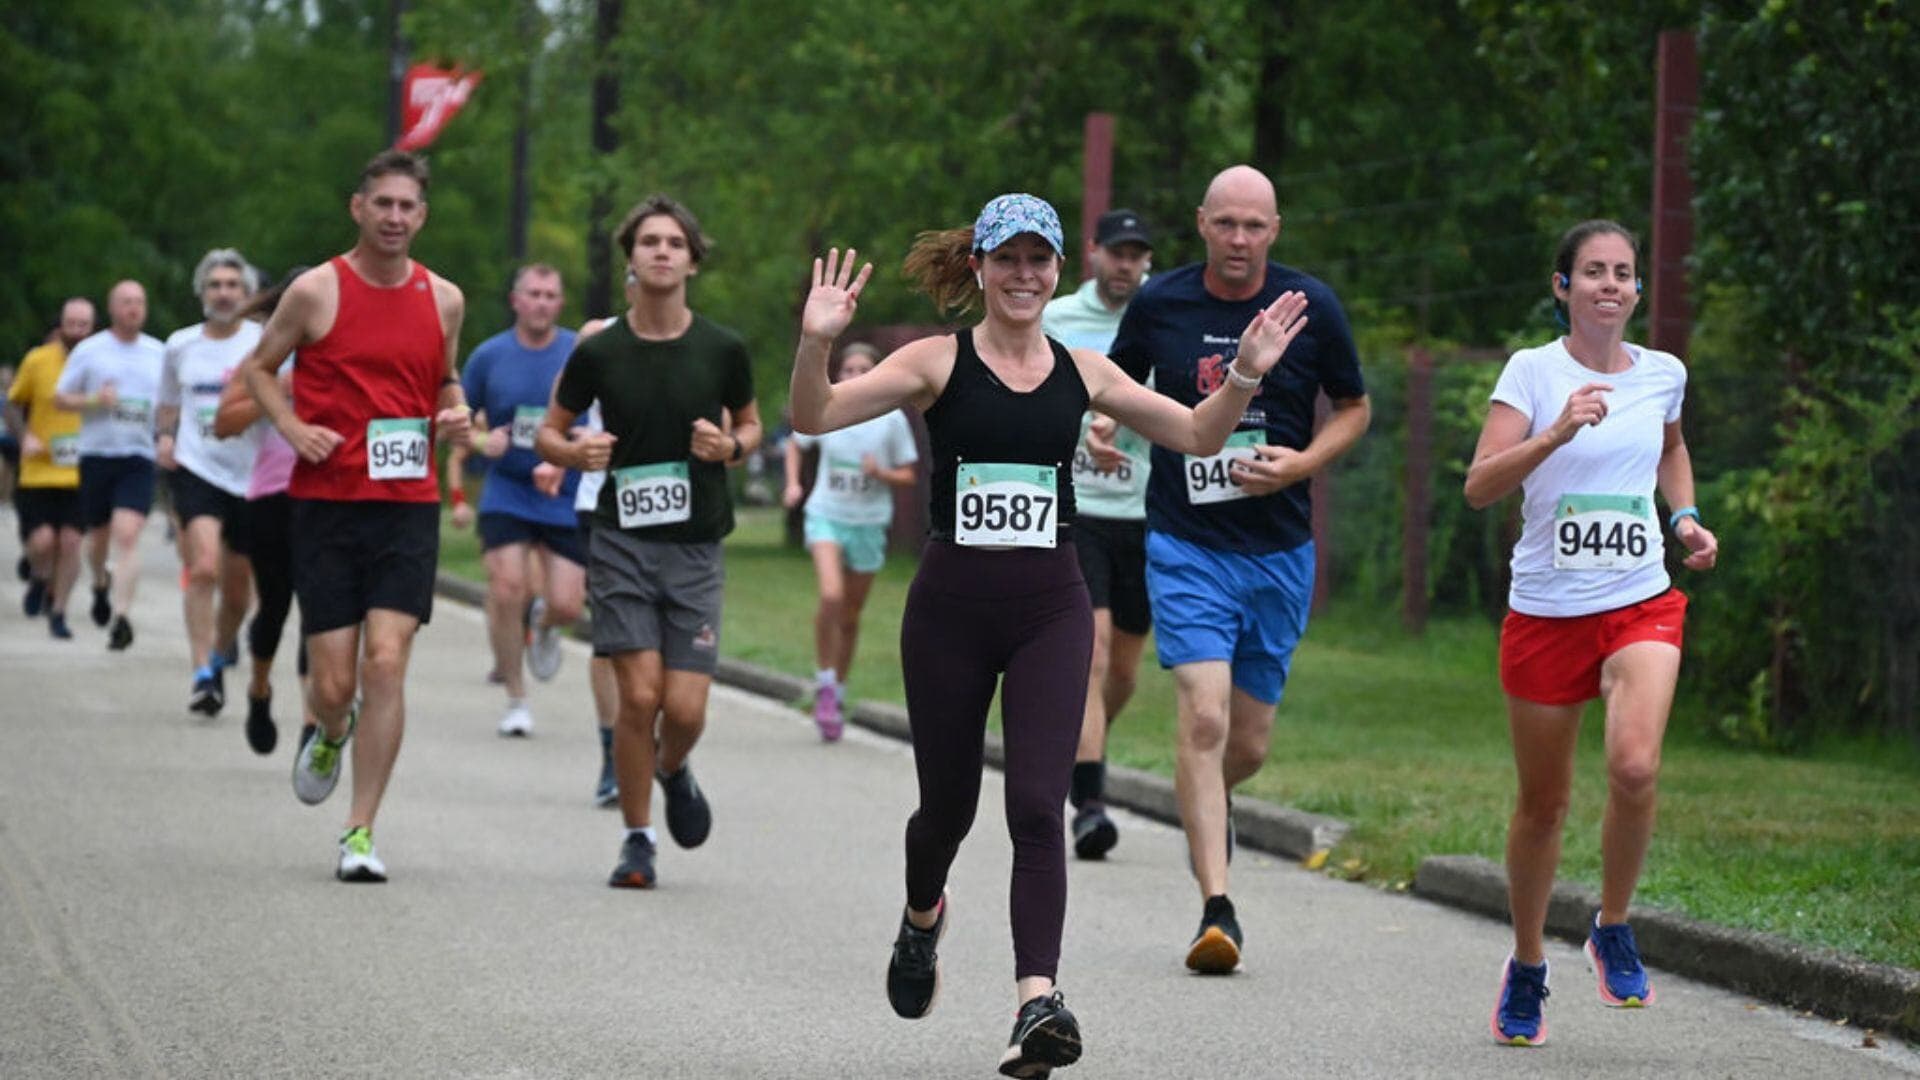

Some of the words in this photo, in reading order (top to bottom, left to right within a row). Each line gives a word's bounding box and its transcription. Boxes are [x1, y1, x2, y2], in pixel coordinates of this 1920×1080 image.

[372, 439, 427, 467] 9540
[621, 483, 687, 516] 9539
[961, 493, 1053, 532] 9587
[1559, 521, 1647, 557] 9446
